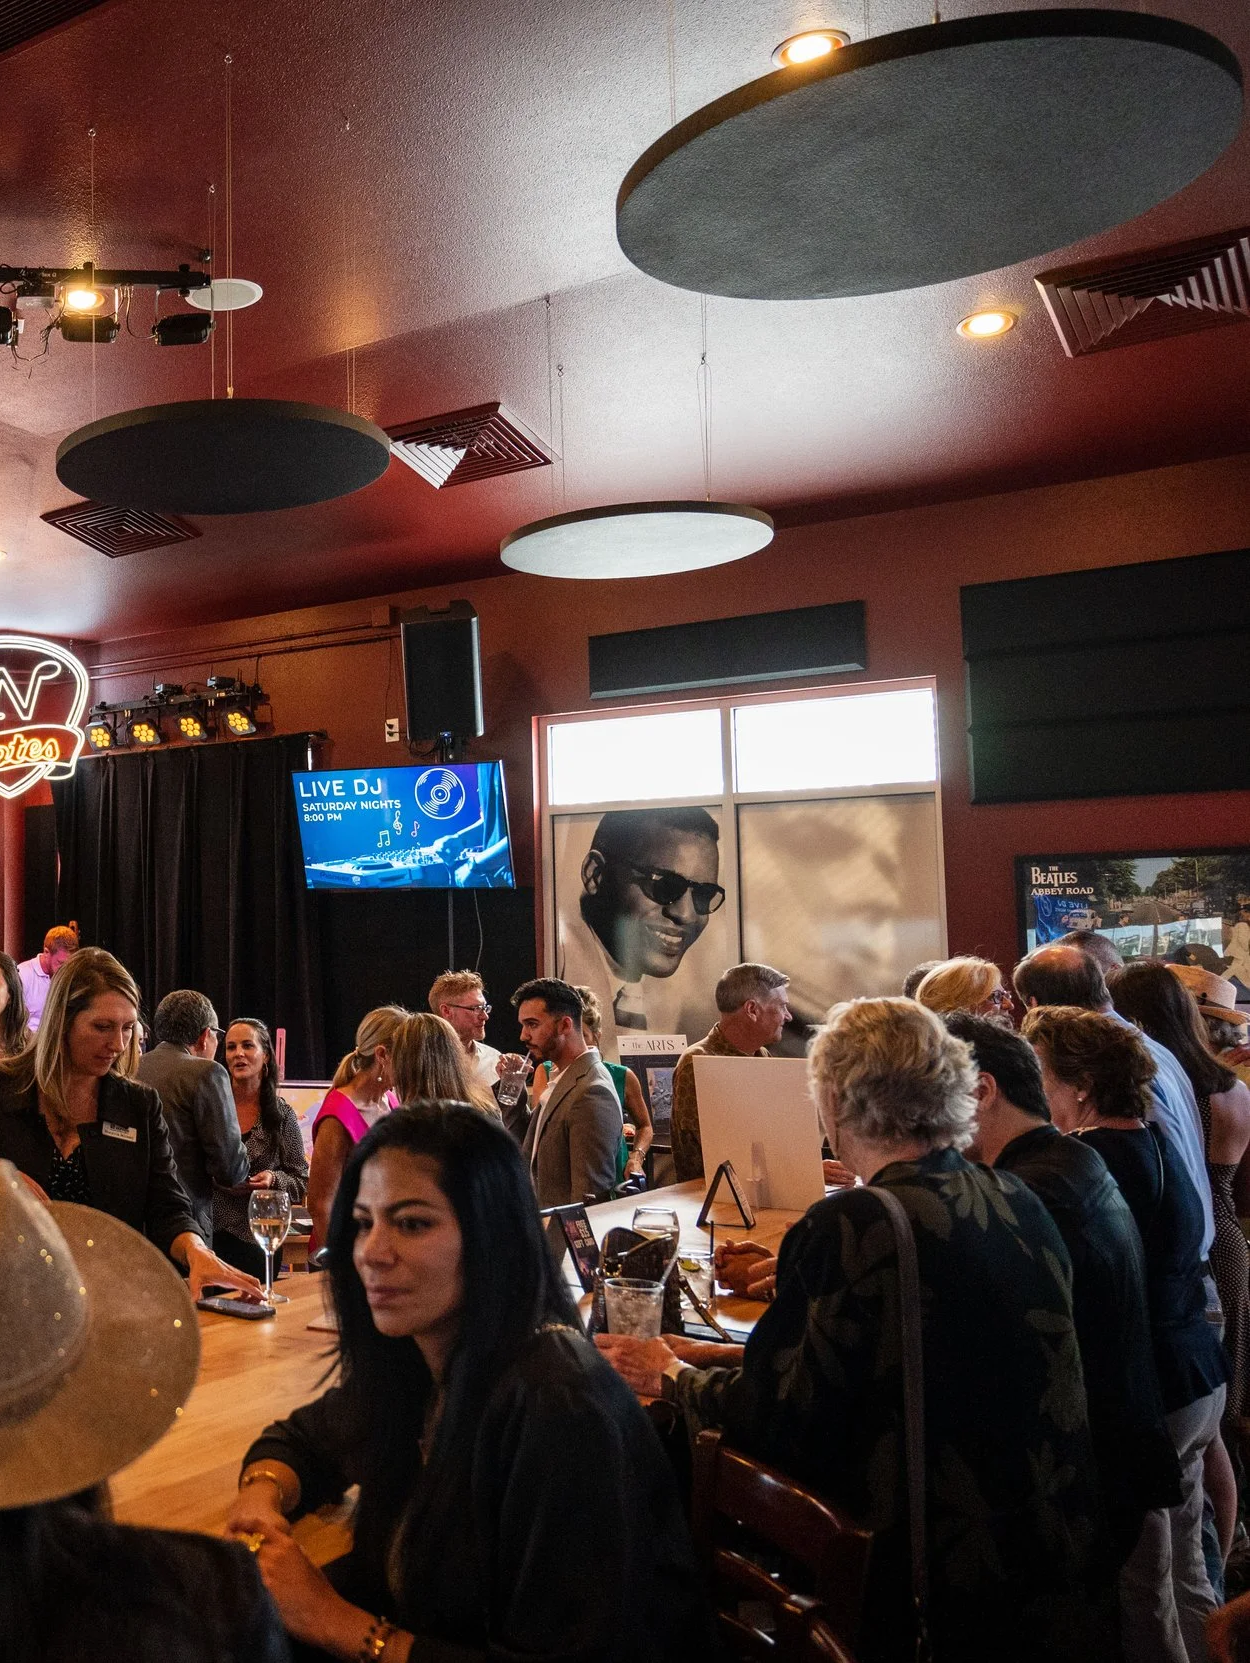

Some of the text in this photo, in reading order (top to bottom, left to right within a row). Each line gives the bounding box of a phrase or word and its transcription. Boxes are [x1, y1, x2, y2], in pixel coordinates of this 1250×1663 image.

[299, 778, 382, 797] LIVE DJ
[303, 800, 401, 811] SATURDAY NIGHTS
[304, 812, 342, 822] 8:00 PM
[1031, 867, 1078, 887] BEATLES
[1031, 887, 1094, 896] ABBEY ROAD
[646, 1039, 675, 1051] ARTS
